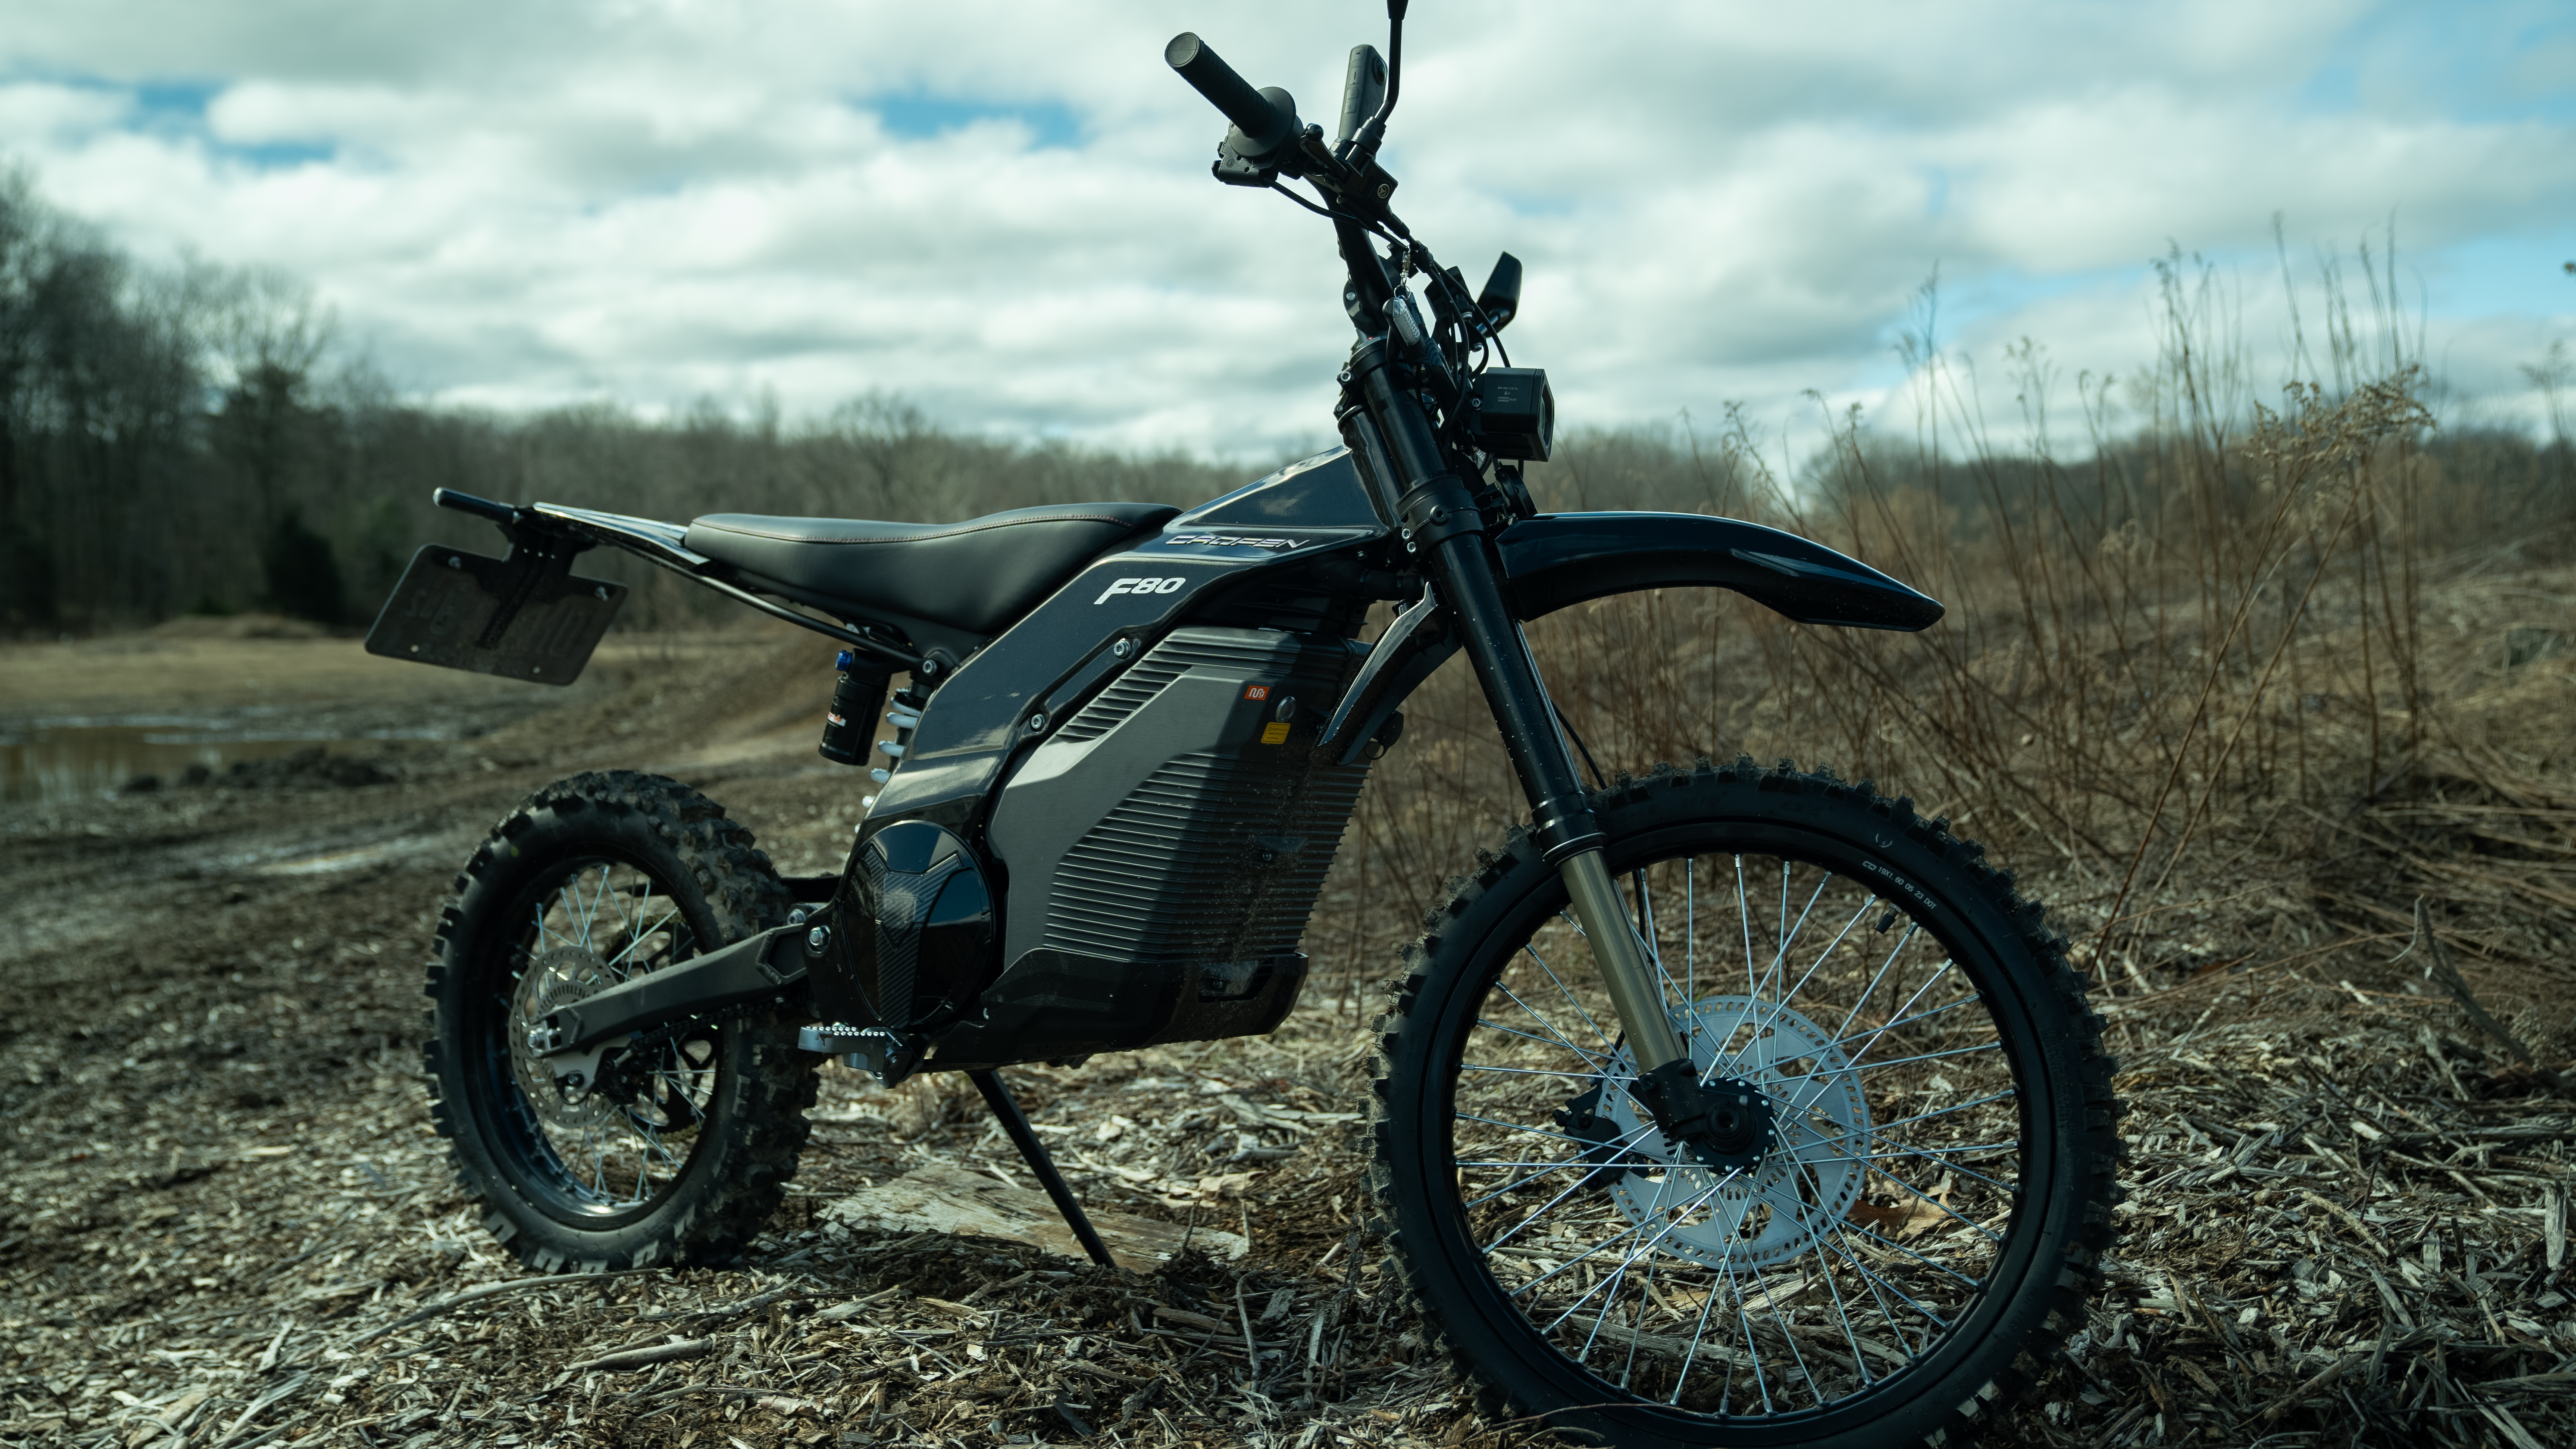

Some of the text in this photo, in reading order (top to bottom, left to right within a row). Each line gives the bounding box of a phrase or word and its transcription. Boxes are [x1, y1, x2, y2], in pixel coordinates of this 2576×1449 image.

[1093, 578, 1186, 605] F80
[1779, 799, 1823, 817] 42M
[1904, 883, 1915, 892] 05
[1914, 890, 1924, 899] 23
[1923, 898, 1937, 910] DOT
[2023, 1286, 2039, 1308] NOT
[2008, 1310, 2025, 1331] FOR
[1973, 1332, 2011, 1371] HIGHWAY
[1953, 1373, 1974, 1393] USE
